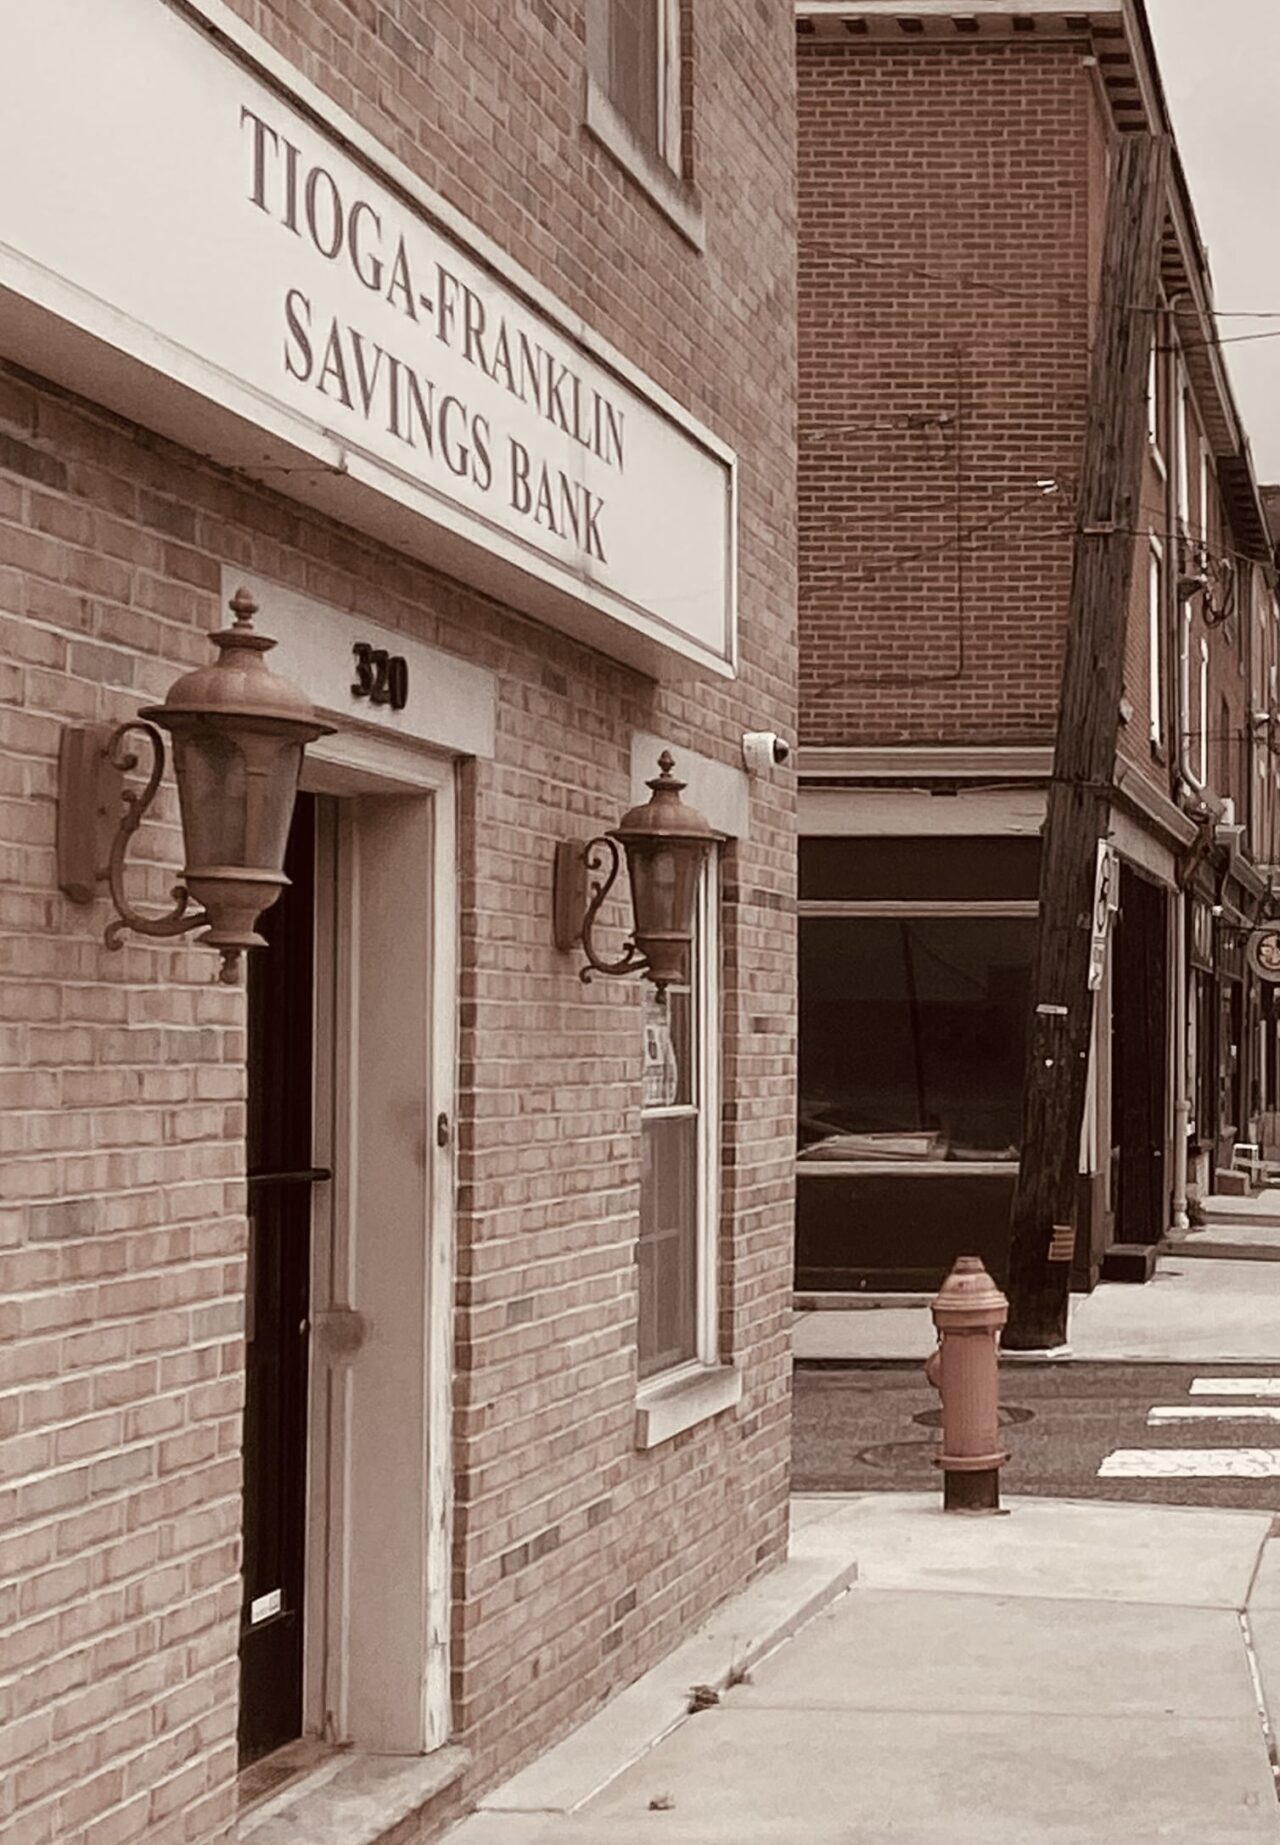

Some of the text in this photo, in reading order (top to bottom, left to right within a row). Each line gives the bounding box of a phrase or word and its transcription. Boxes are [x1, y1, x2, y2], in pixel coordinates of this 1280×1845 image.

[240, 104, 624, 475] TIOGA-FRANKLIN
[285, 288, 607, 565] SAVINGS BANK
[351, 642, 409, 711] 320
